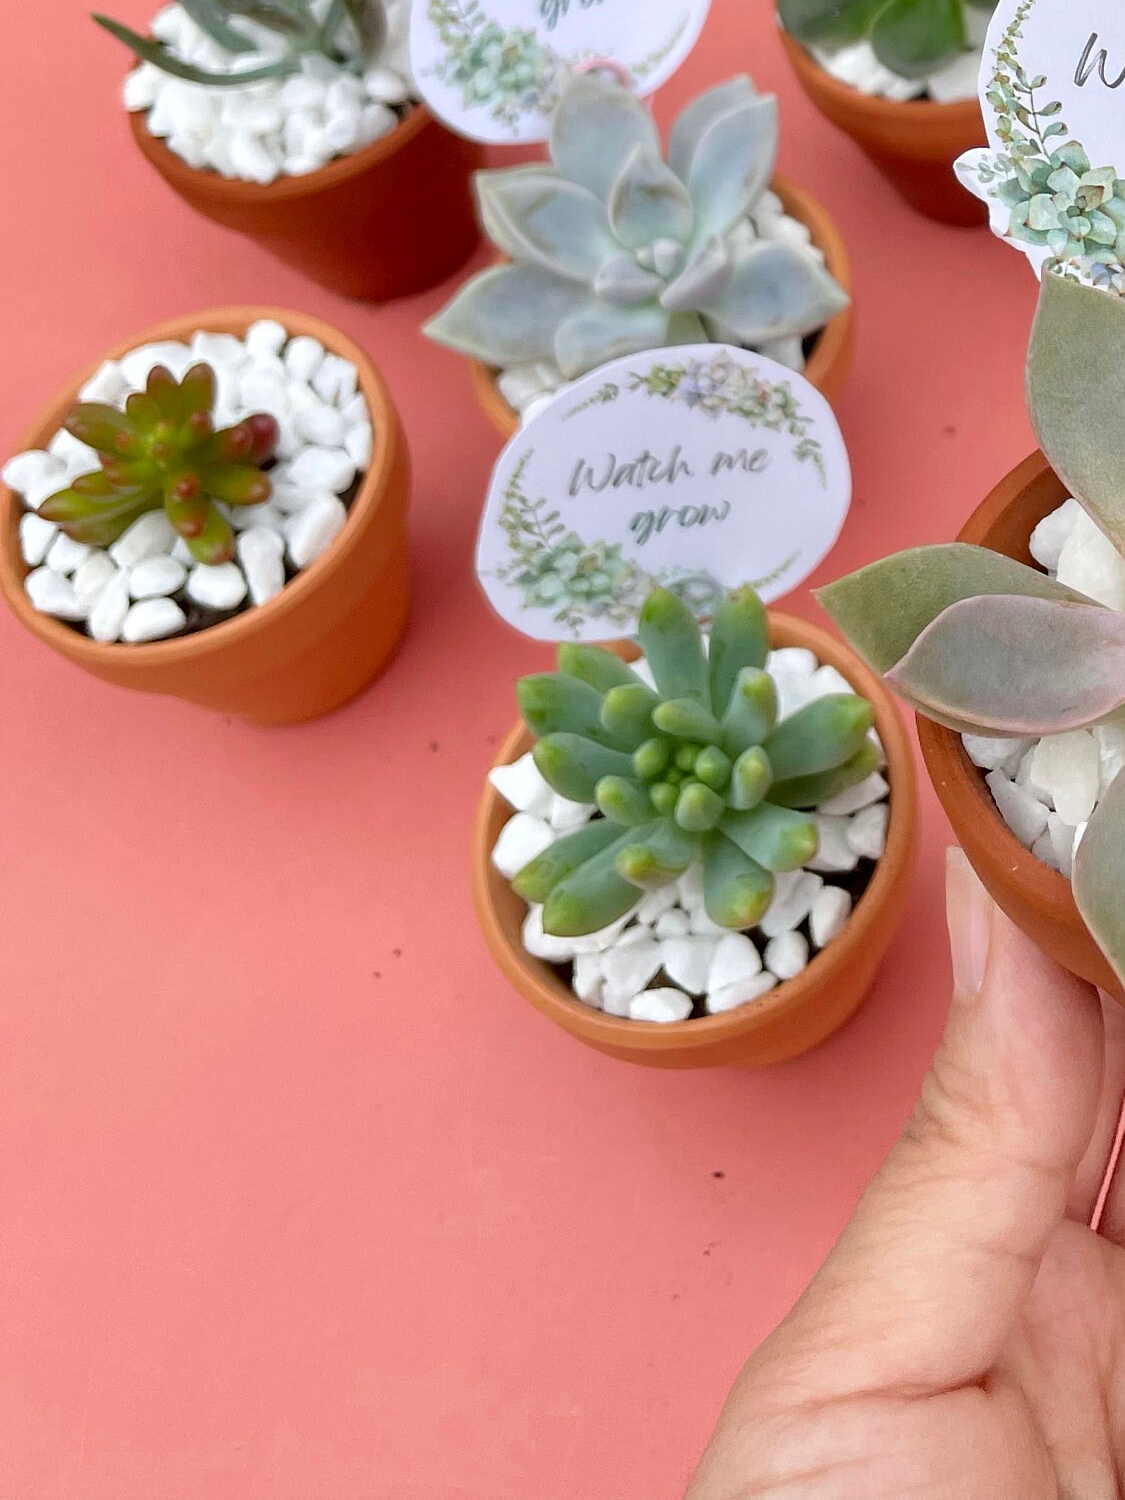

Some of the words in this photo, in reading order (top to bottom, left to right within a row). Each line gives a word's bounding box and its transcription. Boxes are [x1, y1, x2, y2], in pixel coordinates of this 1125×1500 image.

[568, 444, 692, 497] Watch
[710, 447, 770, 477] me
[630, 500, 732, 545] grow
